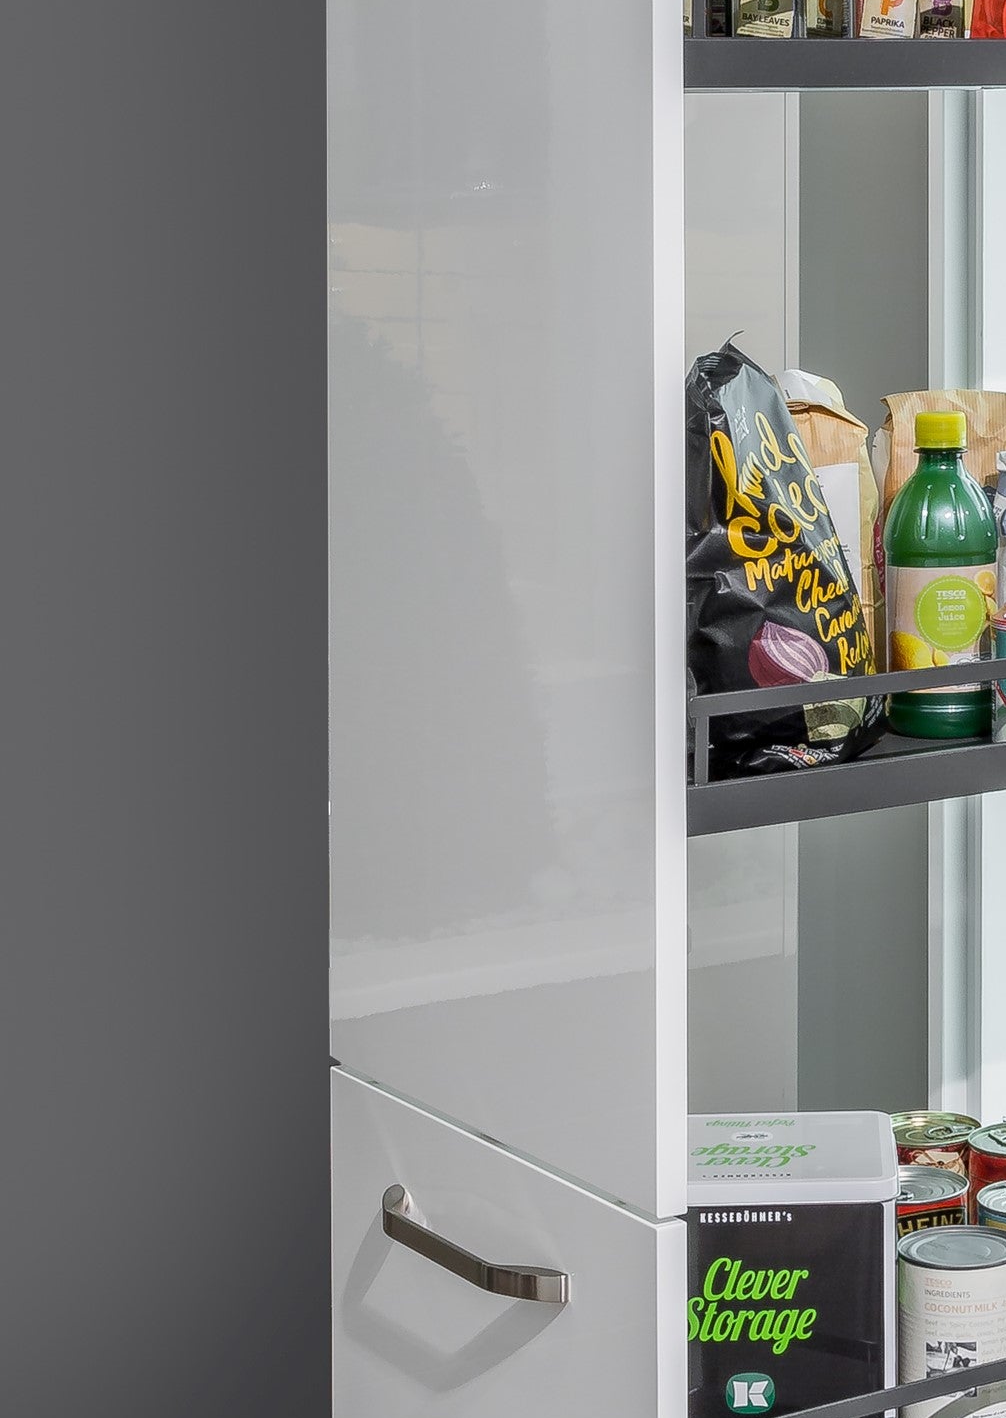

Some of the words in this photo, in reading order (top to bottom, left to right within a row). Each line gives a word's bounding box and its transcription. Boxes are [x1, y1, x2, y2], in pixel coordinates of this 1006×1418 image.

[742, 13, 759, 24] BAY
[760, 15, 789, 27] LEAVES
[871, 17, 905, 29] PAPRIKA
[923, 16, 954, 27] BLACK
[921, 26, 955, 38] PEPPER
[938, 603, 965, 611] Lemon
[938, 612, 965, 621] Juice
[706, 1119, 752, 1128] Fittings
[755, 1119, 796, 1127] Perfect
[690, 1143, 816, 1157] Storage
[696, 1155, 791, 1169] Clever
[898, 1213, 965, 1235] HEINZ
[704, 1257, 809, 1301] Clever
[925, 1289, 971, 1298] INGREDIENTS
[925, 1302, 972, 1314] COCONUT
[974, 1302, 998, 1312] MILK
[687, 1297, 817, 1355] Storage
[733, 1380, 769, 1408] K
